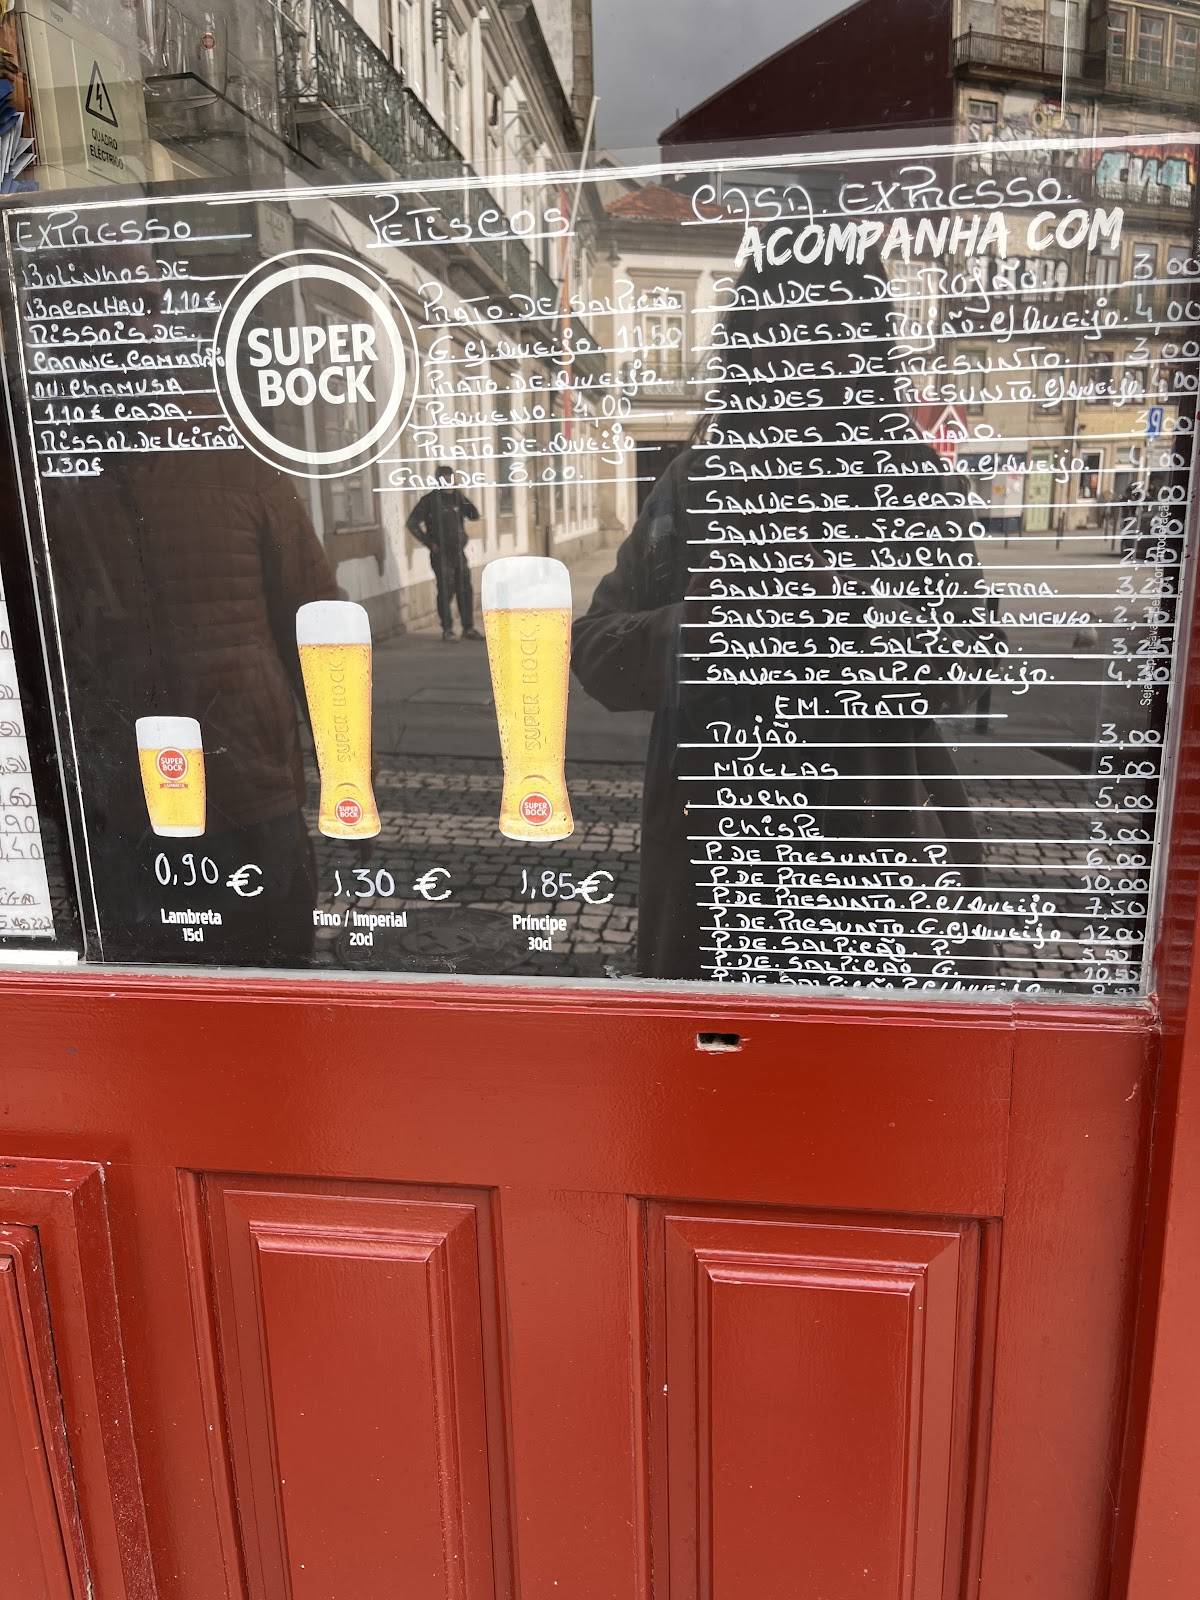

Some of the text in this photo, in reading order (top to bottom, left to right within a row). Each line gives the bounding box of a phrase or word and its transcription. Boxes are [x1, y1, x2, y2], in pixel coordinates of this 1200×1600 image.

[91, 128, 118, 151] QUADRO
[16, 210, 191, 252] EXPRESSO
[734, 206, 1125, 273] ACOMPANHA COM
[156, 260, 190, 280] DE
[247, 322, 379, 367] SUPER
[257, 364, 376, 407] BOCK
[705, 389, 823, 412] SANDES
[706, 423, 823, 449] SANDES
[707, 521, 809, 546] SANDES
[709, 550, 814, 573] SANDES
[823, 550, 856, 567] DE
[709, 578, 817, 598] SANDES
[708, 606, 814, 627] SANDES
[822, 609, 850, 625] DE
[709, 632, 817, 658] SANDES
[706, 664, 797, 685] SANDES
[805, 667, 831, 681] DE
[160, 757, 184, 766] SUPER
[162, 764, 184, 772] BOCK
[338, 805, 359, 814] SUPER
[340, 811, 358, 819] BOCK
[523, 801, 549, 811] SUPER
[525, 808, 547, 817] BOCK
[731, 845, 761, 862] DE
[154, 852, 219, 886] 0,90
[160, 908, 222, 925] Lambreta
[312, 910, 342, 926] Fino
[352, 911, 408, 931] Imperial
[512, 914, 567, 935] Príncipe
[183, 927, 204, 942] 15cl
[349, 932, 373, 946] 20cl
[528, 937, 552, 951] 30cl
